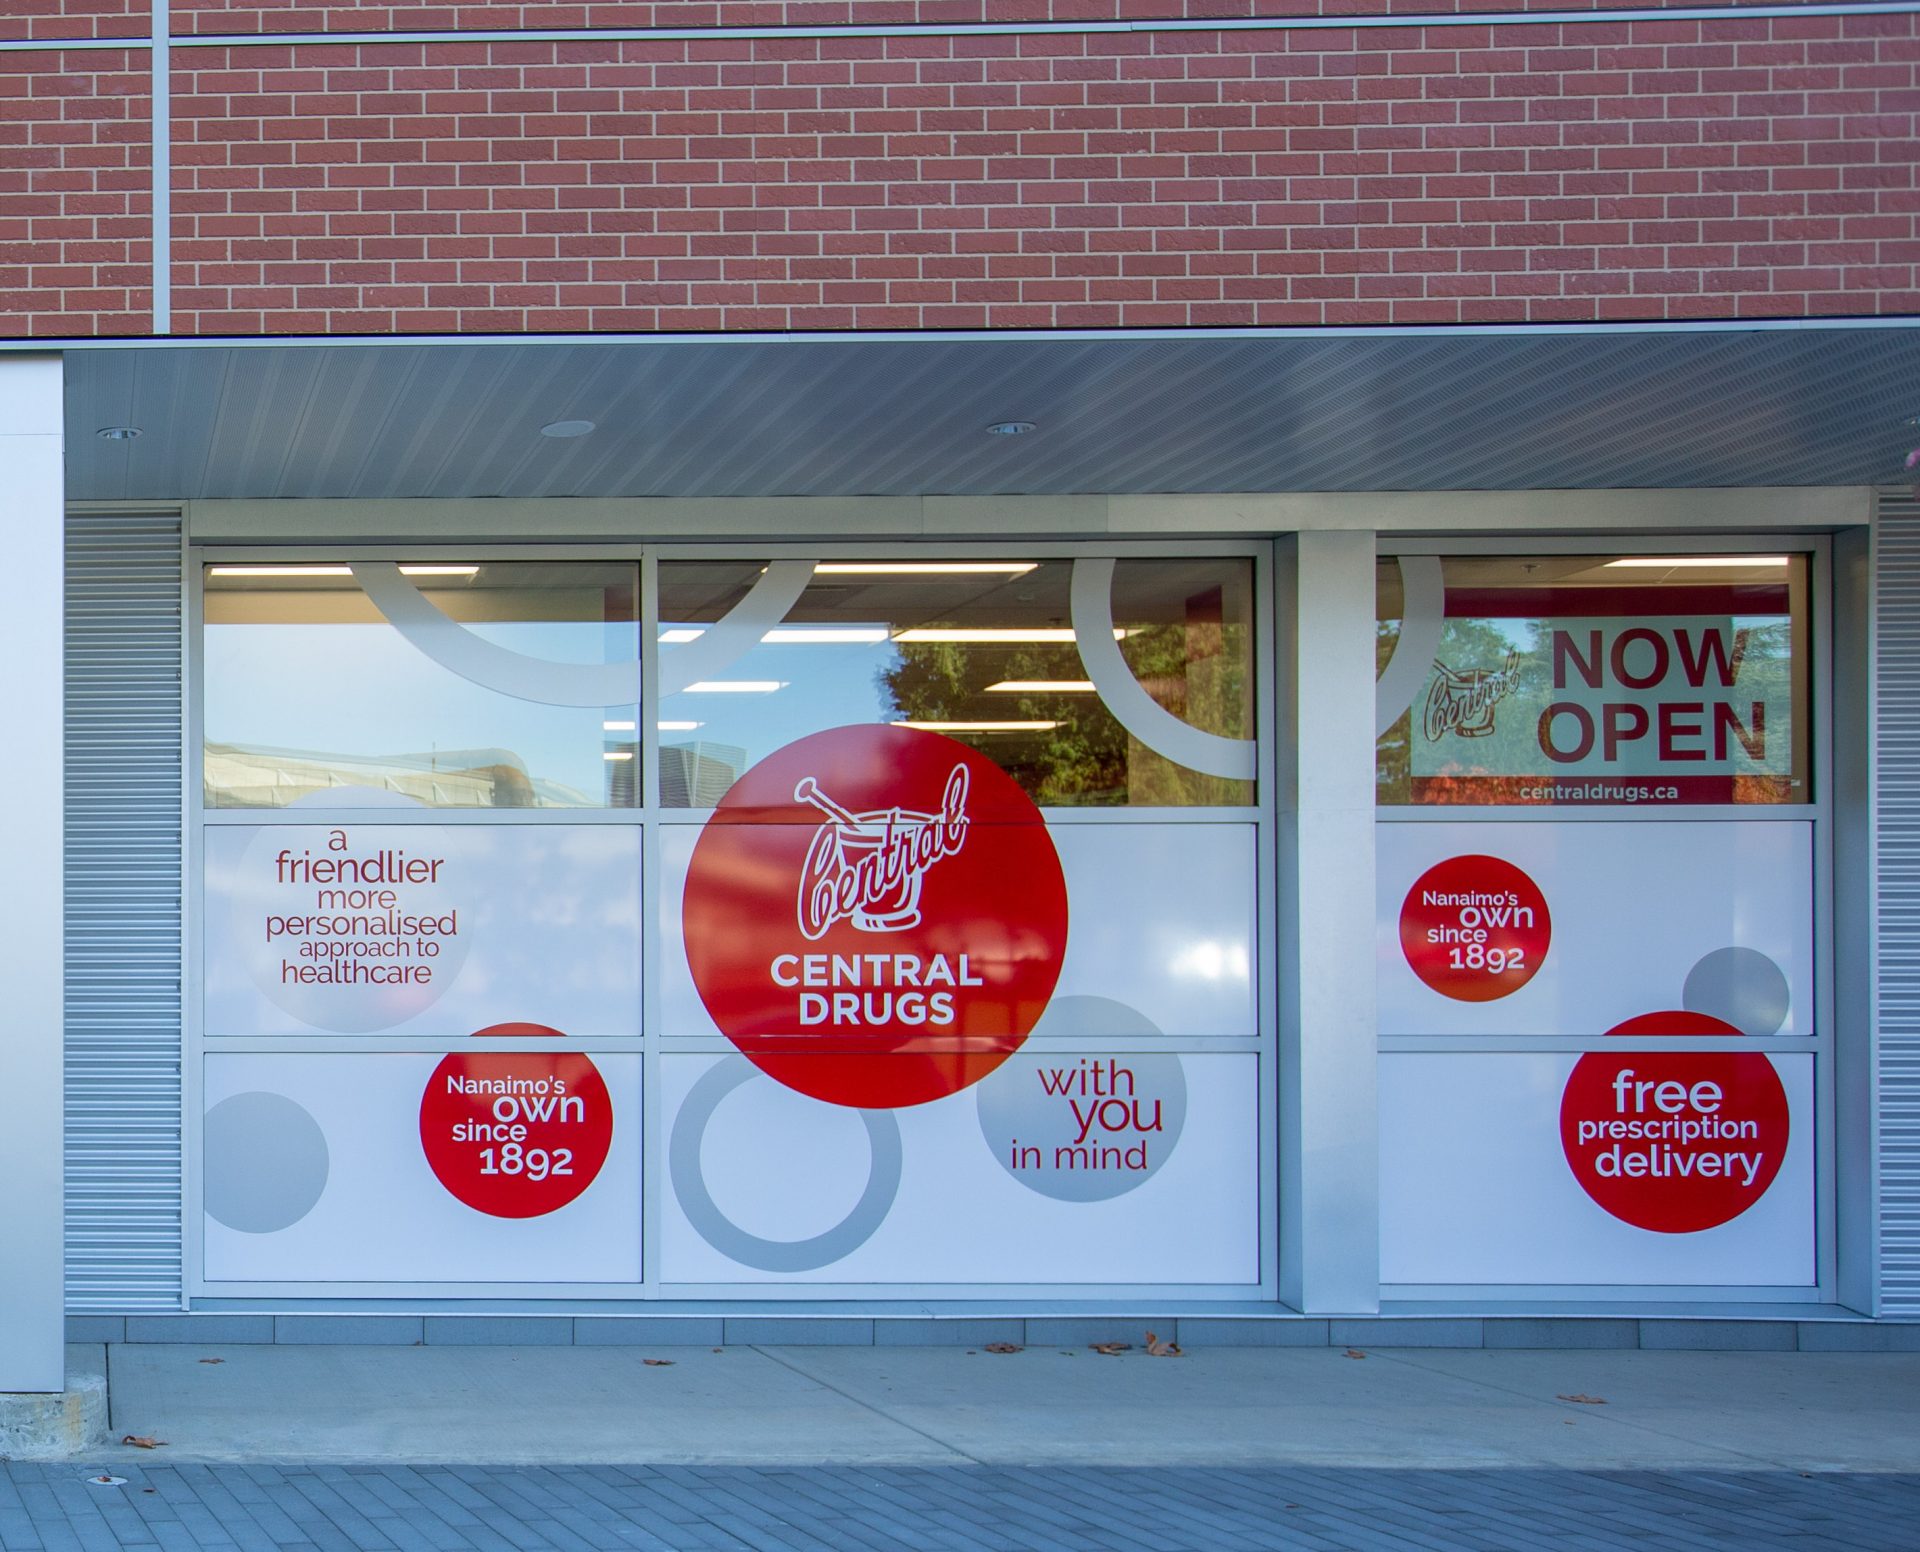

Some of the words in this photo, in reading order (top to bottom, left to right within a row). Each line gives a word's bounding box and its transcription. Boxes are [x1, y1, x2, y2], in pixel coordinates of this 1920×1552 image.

[1553, 628, 1750, 689] NOW
[1424, 644, 1521, 743] Central
[1537, 701, 1765, 762] OPEN
[1520, 783, 1679, 802] centraldrugs.ca
[328, 830, 347, 851] a
[796, 762, 970, 940] Central
[276, 850, 444, 883] friendlier
[318, 889, 396, 909] more
[1423, 890, 1518, 906] Nanaimo's
[267, 910, 457, 942] personalised
[1459, 907, 1533, 928] own
[1427, 925, 1488, 943] since
[300, 937, 410, 962] approach
[417, 939, 440, 957] to
[1449, 945, 1525, 974] 1892
[282, 960, 432, 984] healthcare
[770, 954, 983, 987] CENTRAL
[800, 992, 955, 1025] DRUGS
[447, 1075, 565, 1095] Nanaimo's
[1038, 1059, 1134, 1096] with
[1612, 1069, 1722, 1113] free
[493, 1096, 584, 1123] own
[1069, 1100, 1162, 1144] you
[452, 1118, 527, 1142] since
[1578, 1115, 1758, 1145] prescription
[480, 1143, 573, 1181] 1892
[1012, 1140, 1041, 1169] in
[1056, 1140, 1147, 1170] mind
[1595, 1144, 1762, 1186] delivery
